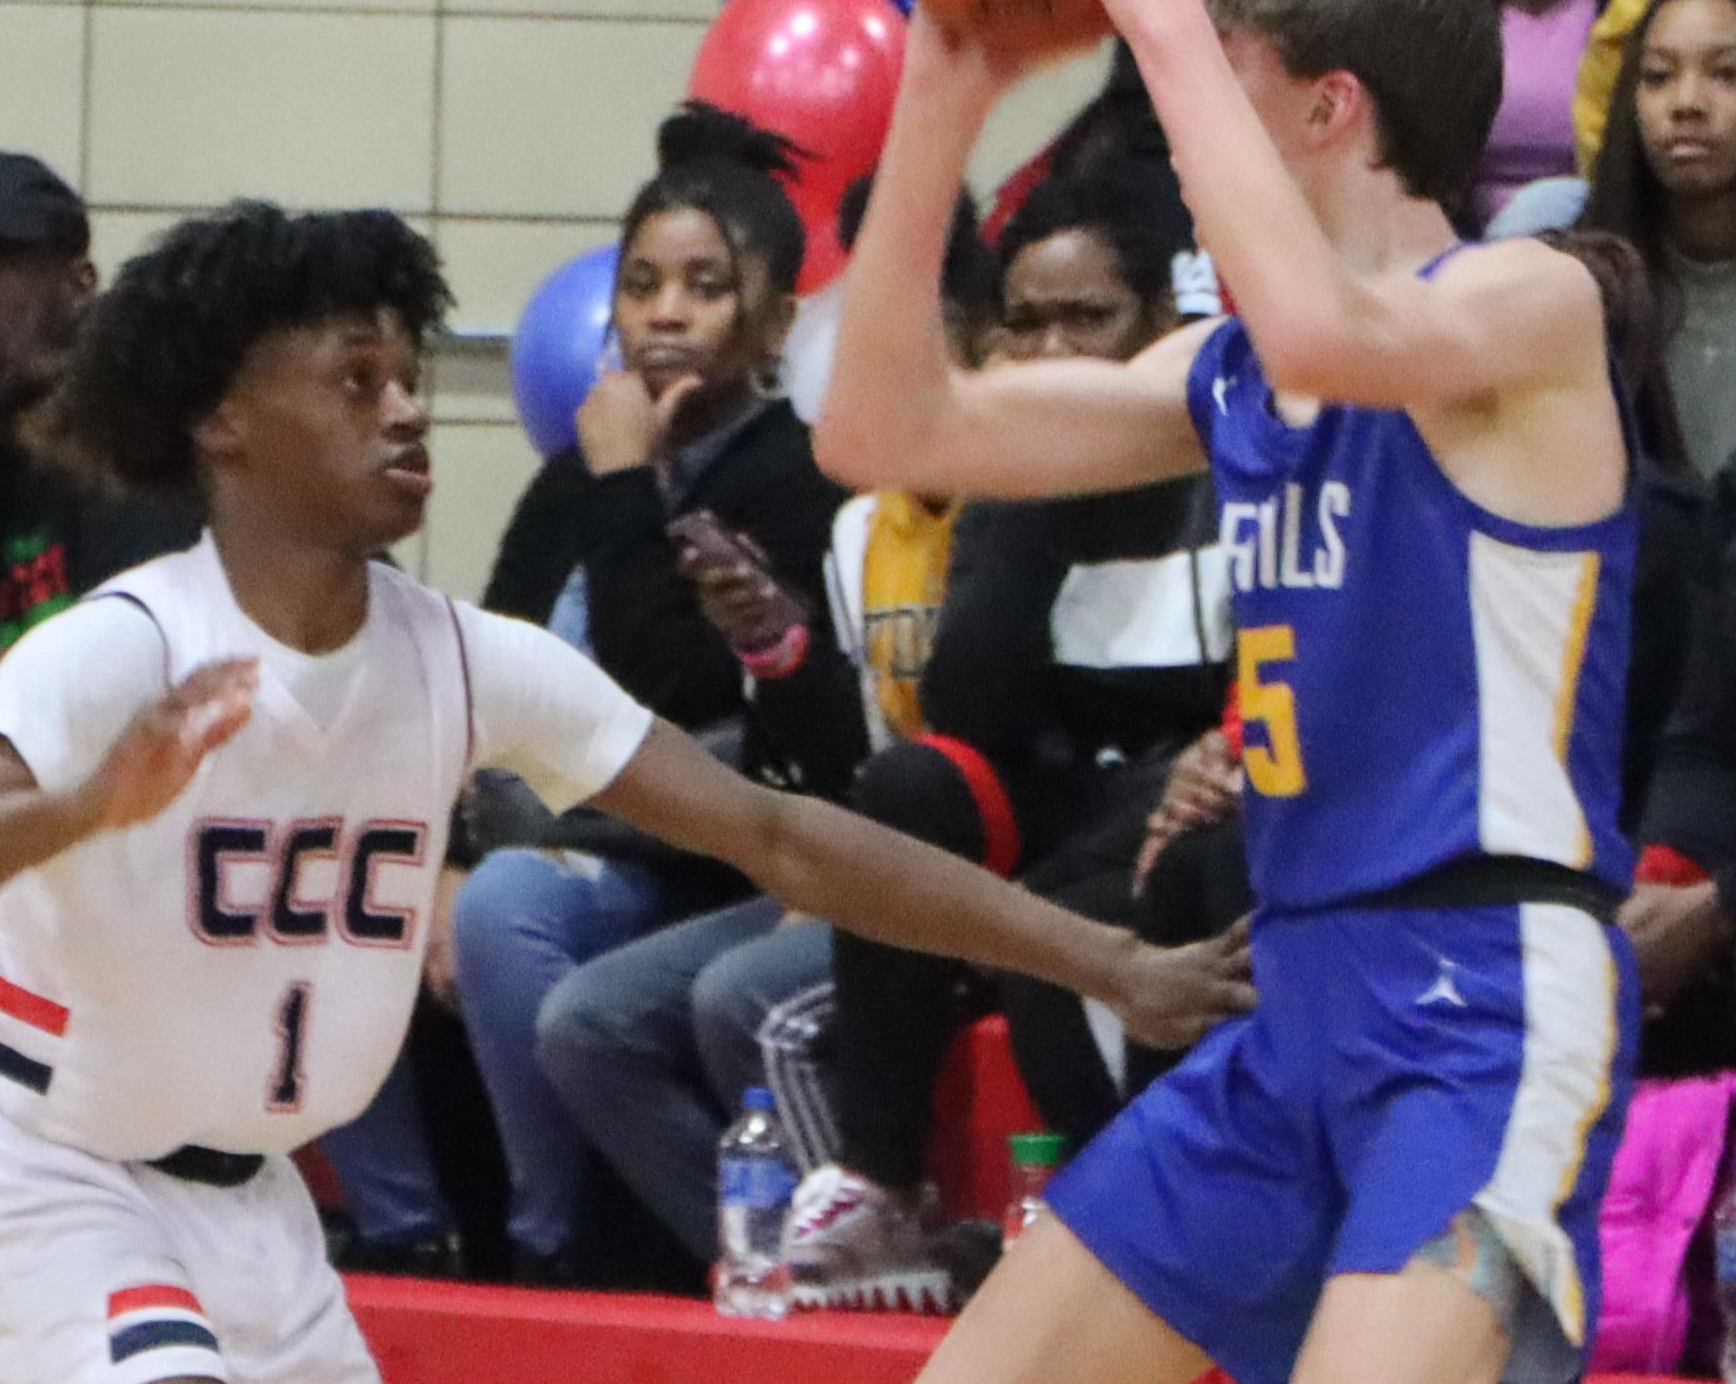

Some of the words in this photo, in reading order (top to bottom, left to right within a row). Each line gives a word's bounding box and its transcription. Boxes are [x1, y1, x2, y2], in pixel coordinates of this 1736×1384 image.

[1237, 624, 1308, 798] 5
[186, 814, 428, 951] CCC
[266, 980, 314, 1114] 1
